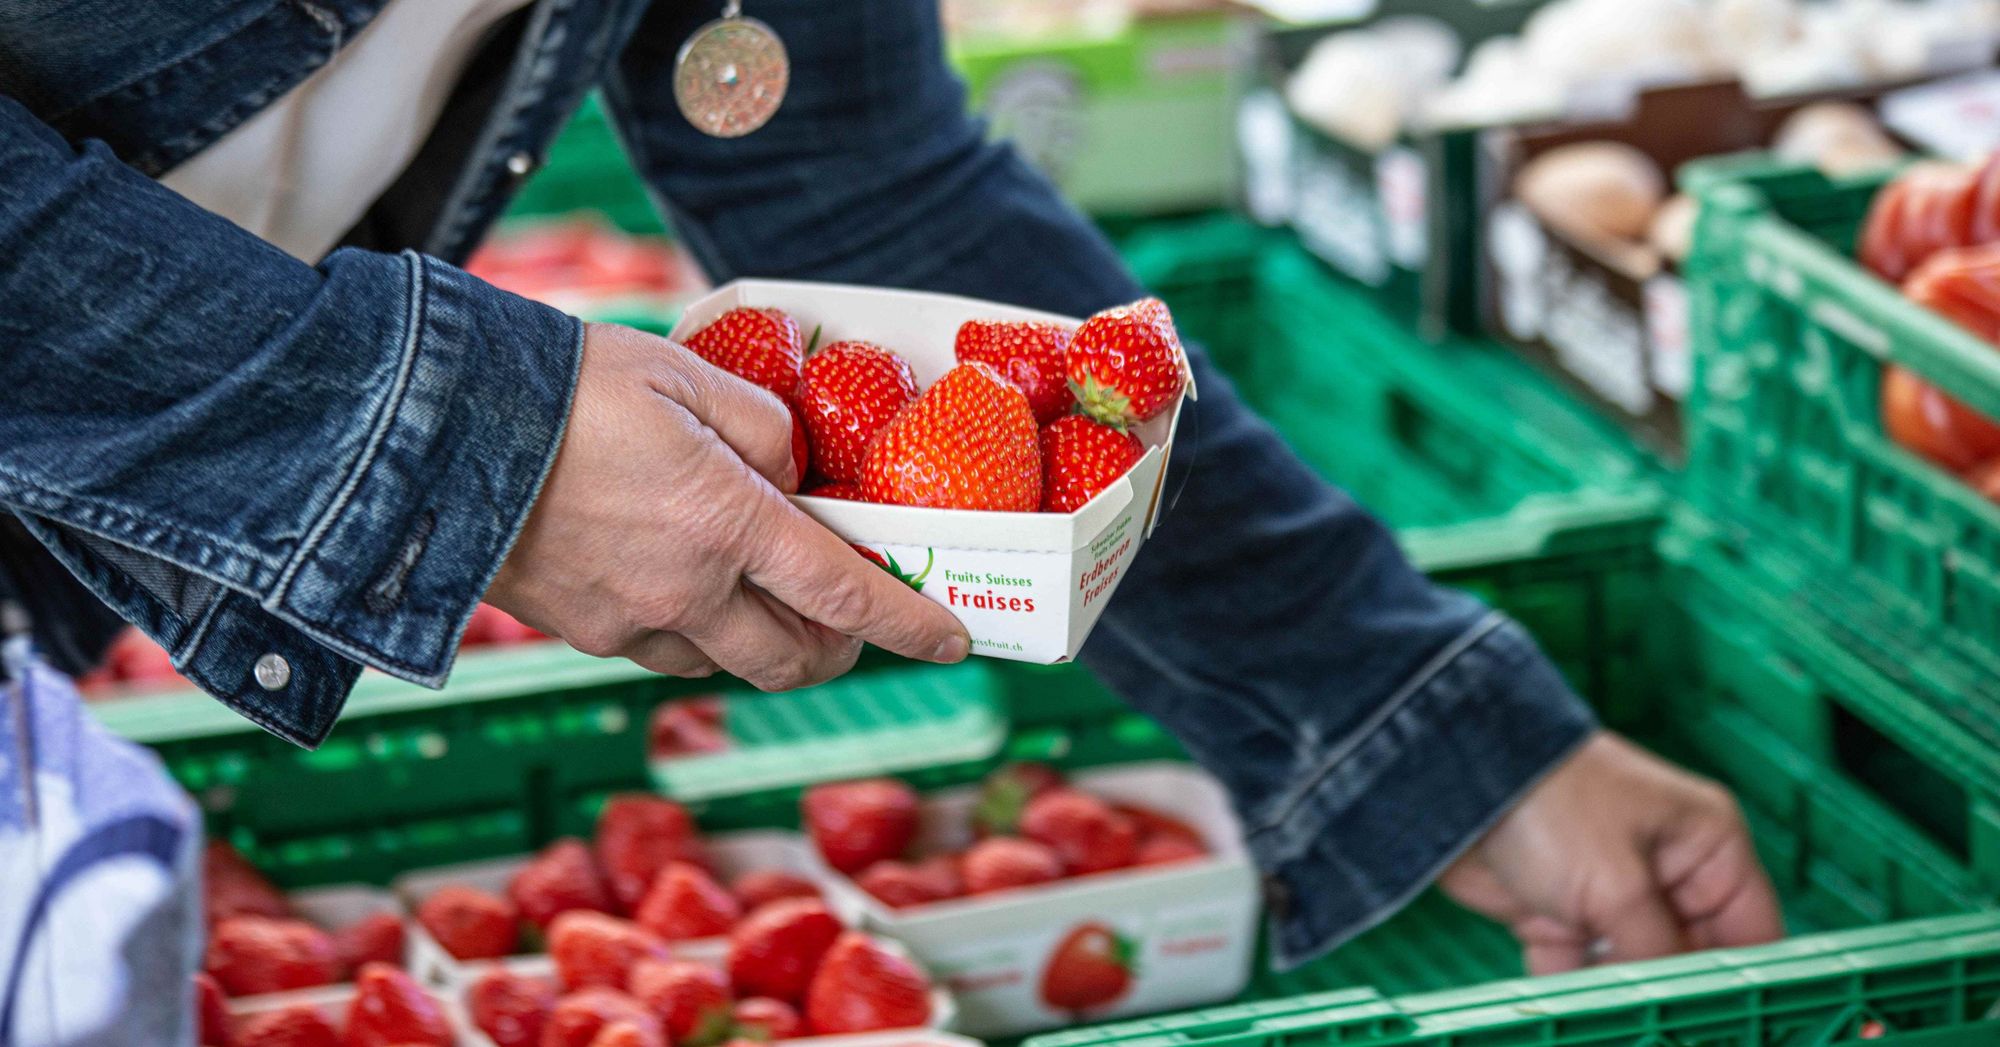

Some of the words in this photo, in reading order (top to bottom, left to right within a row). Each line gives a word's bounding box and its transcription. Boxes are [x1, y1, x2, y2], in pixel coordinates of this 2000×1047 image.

[945, 569, 981, 583] Fruits
[986, 573, 1032, 587] Suisses
[1080, 537, 1131, 591] Erdbeeren
[948, 586, 1035, 612] Fraises
[1084, 566, 1119, 608] Fraises
